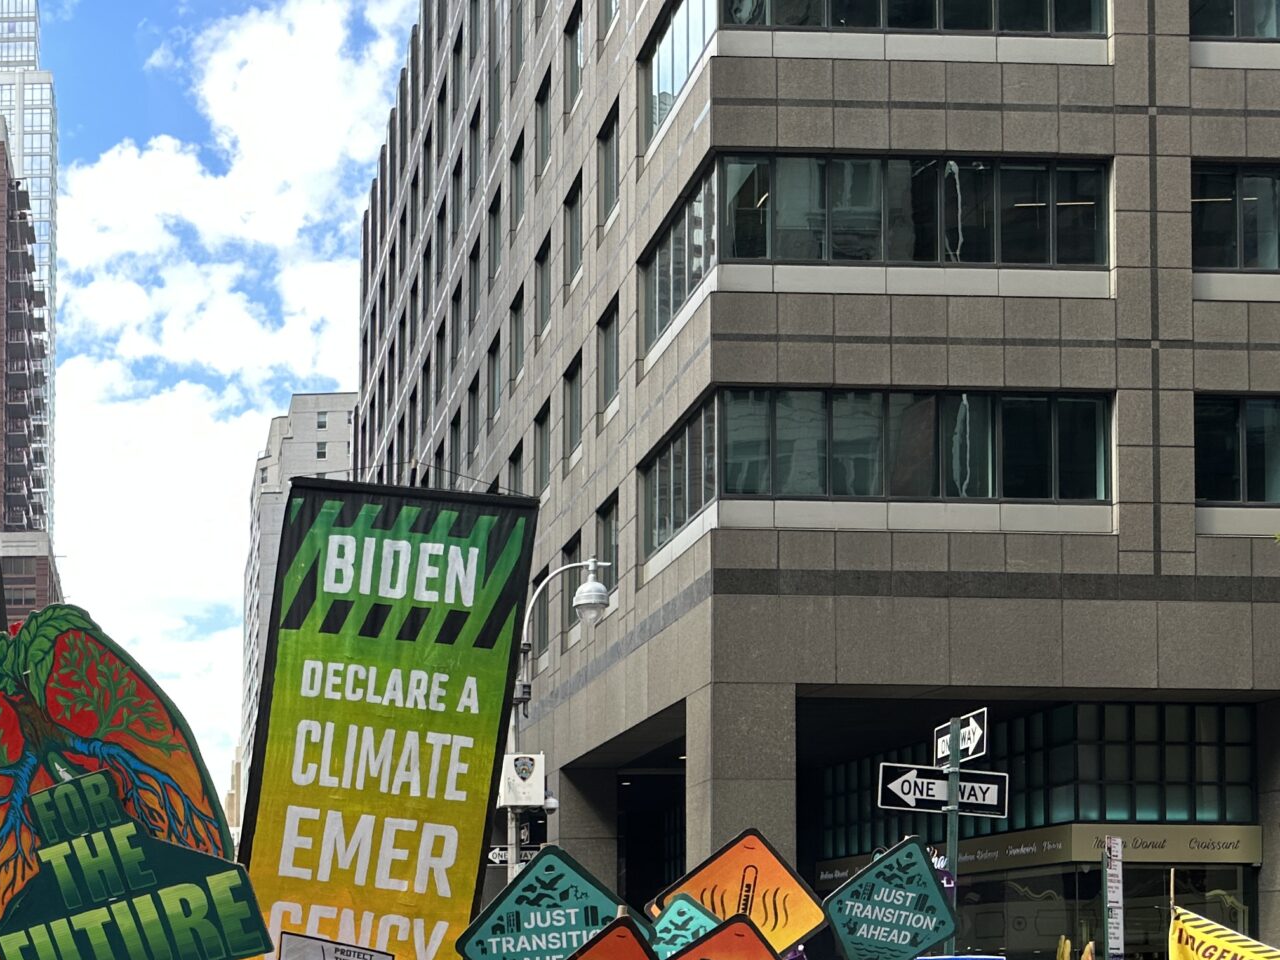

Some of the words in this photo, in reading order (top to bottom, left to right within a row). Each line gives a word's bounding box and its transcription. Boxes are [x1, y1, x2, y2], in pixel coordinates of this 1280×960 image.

[322, 534, 479, 607] BIDEN
[300, 658, 446, 713] DECLARE
[457, 676, 480, 714] A
[941, 736, 950, 755] ON
[960, 726, 977, 747] WAY
[291, 719, 474, 801] CLIMATE
[900, 779, 936, 798] ONE
[31, 772, 121, 843] FOR
[277, 804, 458, 898] EMER
[492, 852, 508, 860] ONE
[520, 852, 534, 860] AY
[1092, 836, 1127, 849] Itan
[1189, 838, 1241, 851] Croissant
[38, 822, 157, 909] THE
[874, 887, 917, 907] JUST
[524, 908, 580, 929] JUST
[845, 900, 937, 931] TRANSITION
[488, 928, 602, 955] TRANSITI
[856, 923, 911, 945] AHEAD
